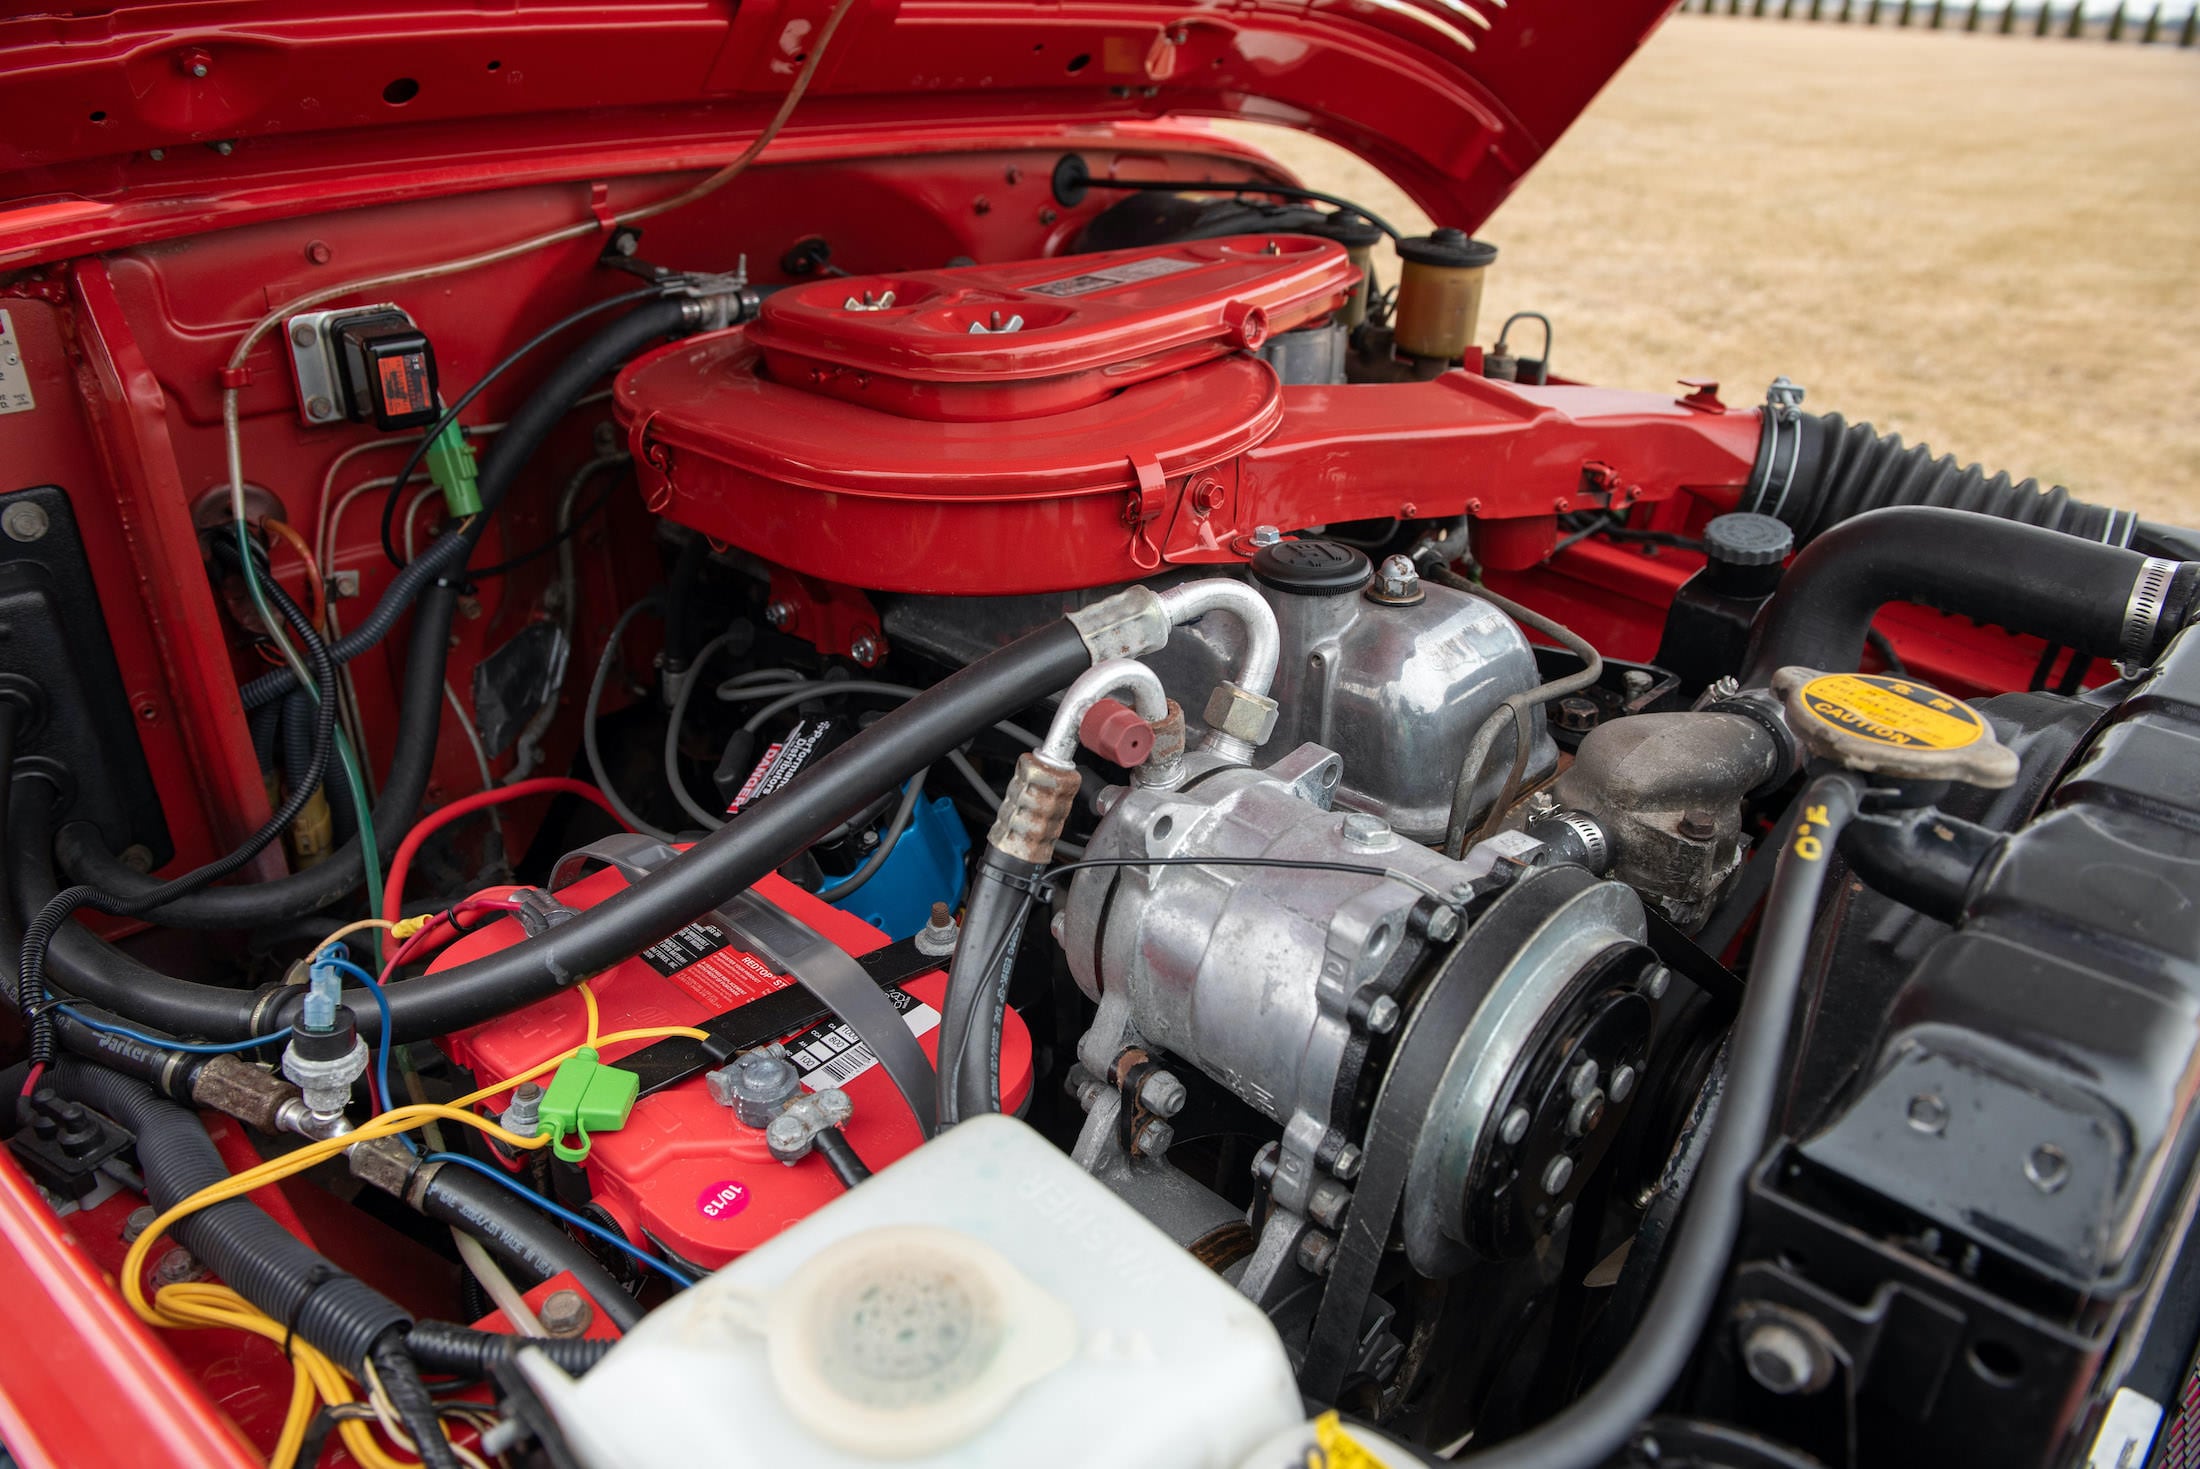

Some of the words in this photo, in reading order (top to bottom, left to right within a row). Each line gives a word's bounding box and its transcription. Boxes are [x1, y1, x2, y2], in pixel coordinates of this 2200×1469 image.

[1813, 702, 1912, 745] CAUTION
[731, 748, 779, 807] DANGER
[762, 738, 807, 795] Distributors
[93, 1031, 150, 1063] Parker
[800, 1055, 815, 1067] 100
[703, 1184, 742, 1217] 10/13
[499, 1231, 523, 1253] MADE
[534, 1255, 554, 1279] USA
